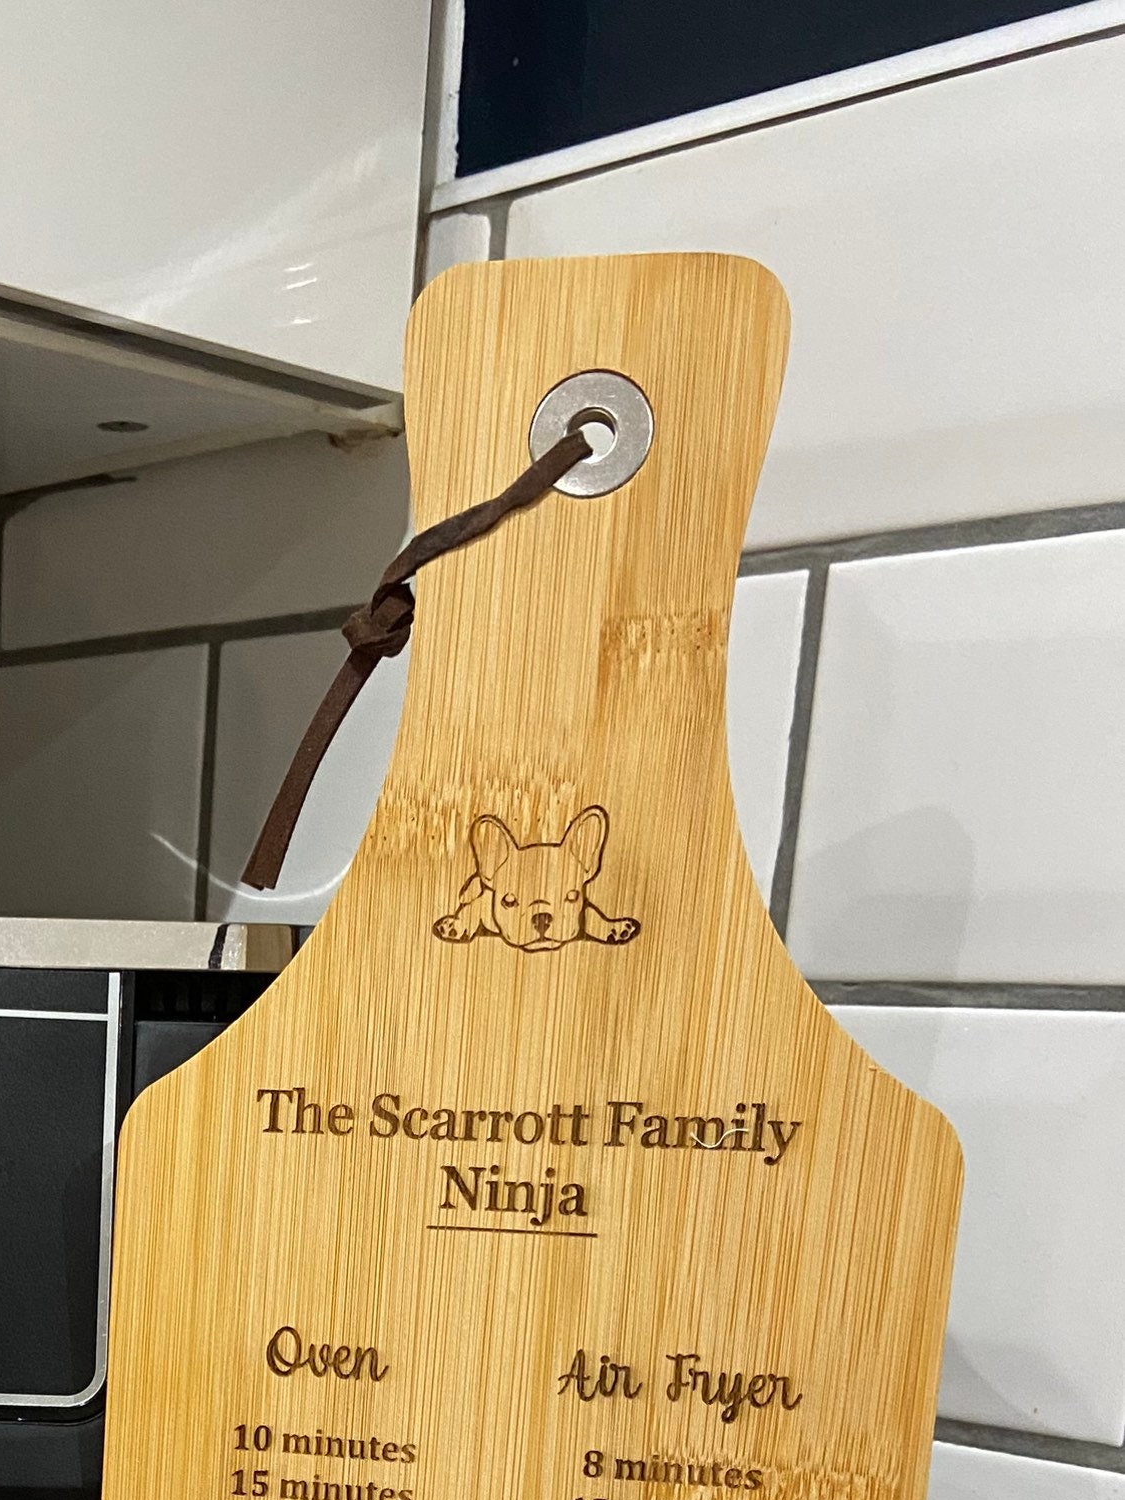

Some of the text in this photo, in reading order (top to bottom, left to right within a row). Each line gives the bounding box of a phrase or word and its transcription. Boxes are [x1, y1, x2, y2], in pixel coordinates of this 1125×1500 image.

[256, 1087, 804, 1167] The Scarrott Family
[438, 1164, 590, 1227] Ninja
[265, 1325, 391, 1382] Oven
[557, 1349, 804, 1424] Air Fryer
[233, 1424, 418, 1463] 10 minutes
[582, 1450, 765, 1491] 8 minutes
[231, 1469, 270, 1497] 15
